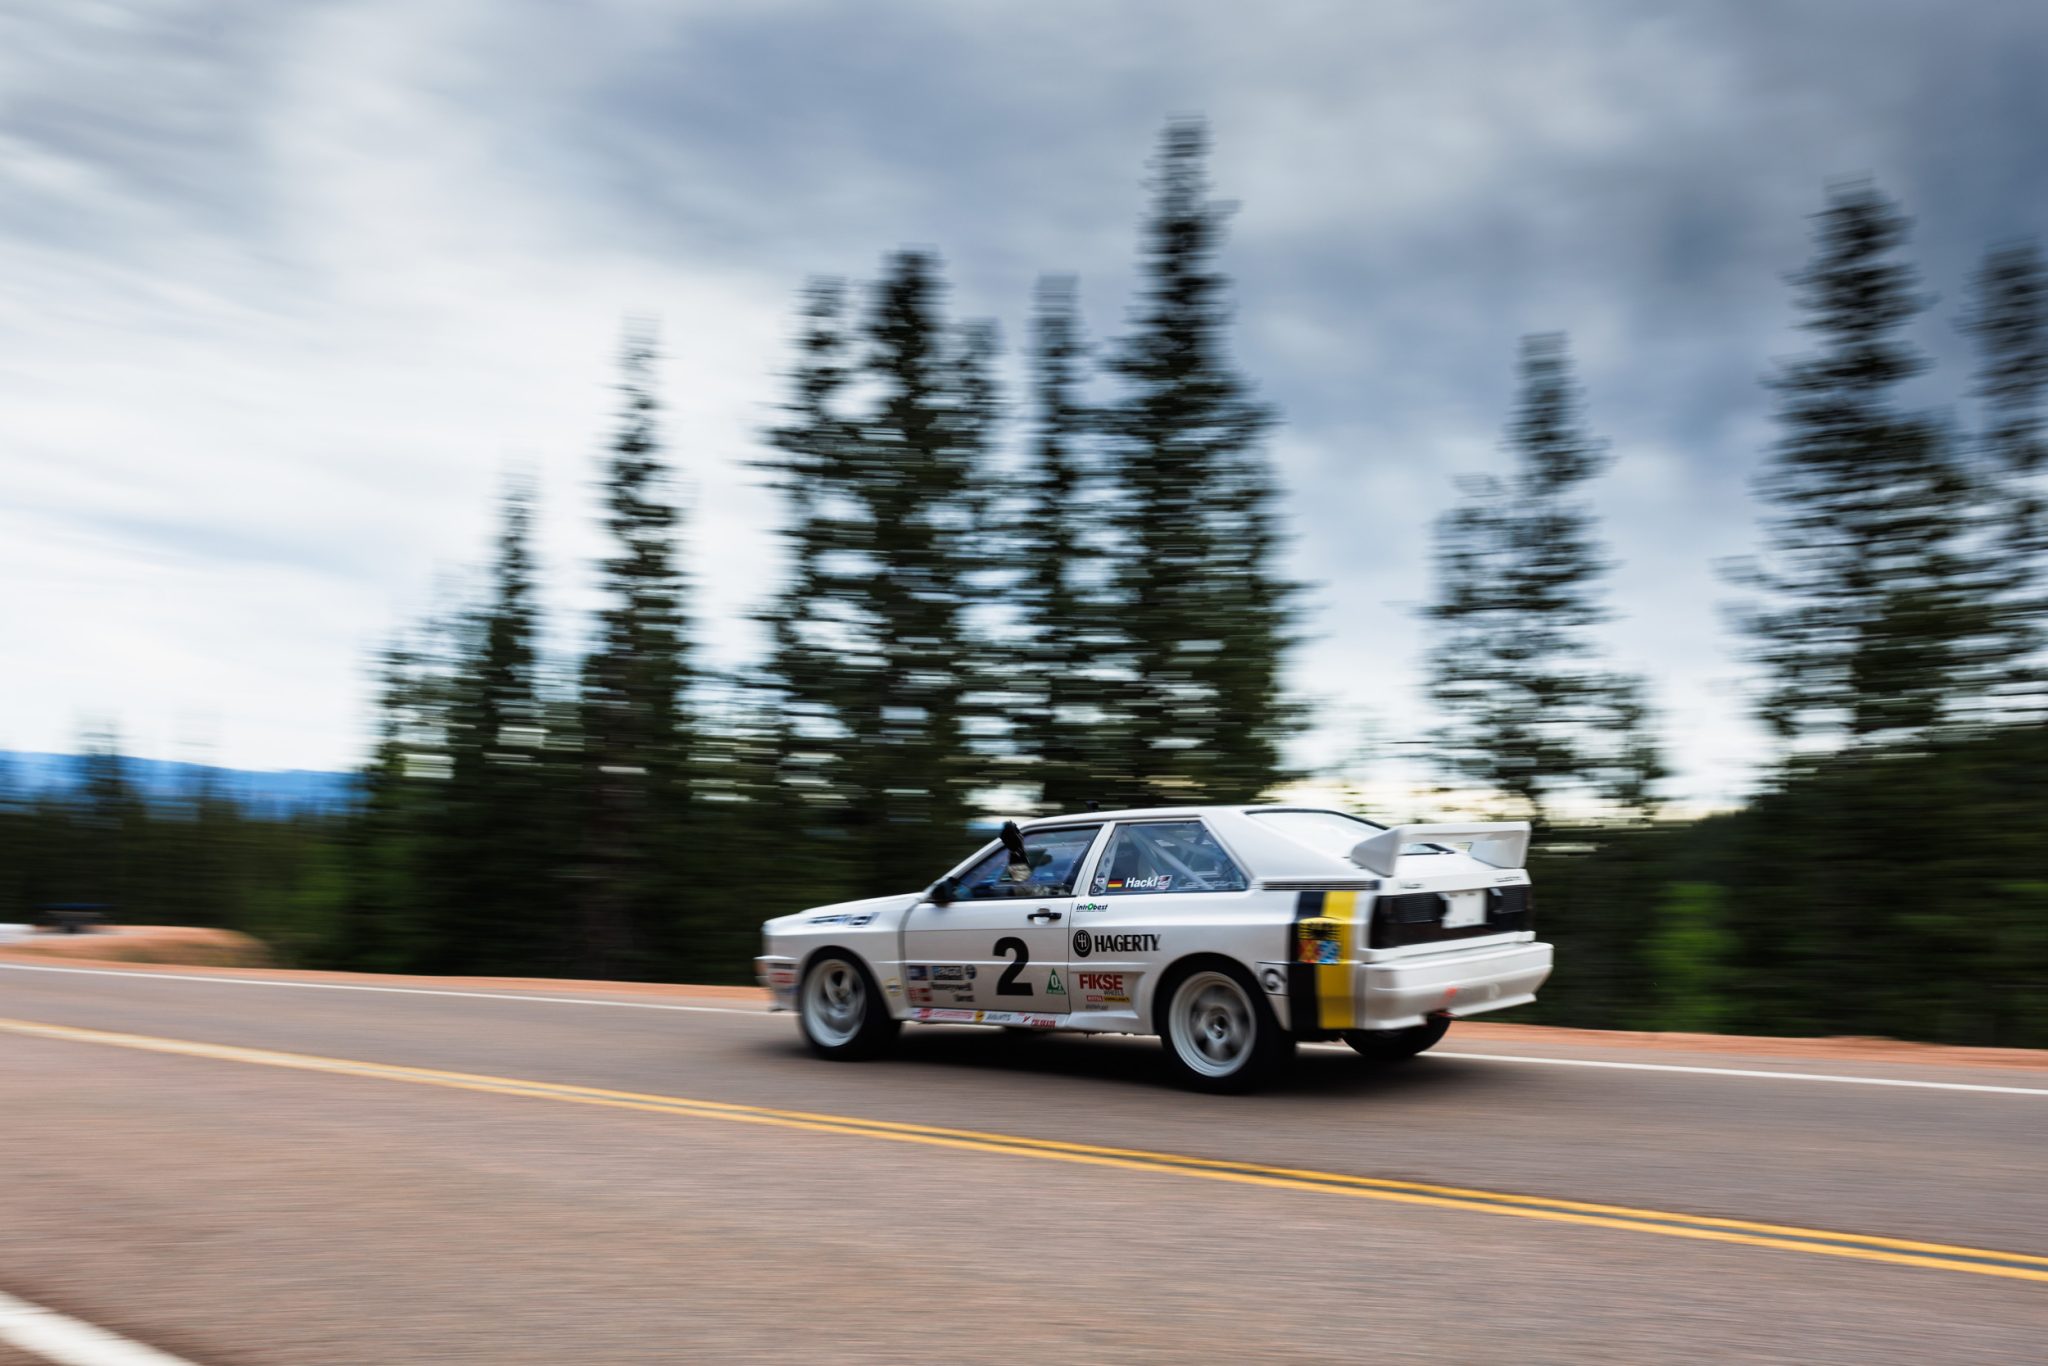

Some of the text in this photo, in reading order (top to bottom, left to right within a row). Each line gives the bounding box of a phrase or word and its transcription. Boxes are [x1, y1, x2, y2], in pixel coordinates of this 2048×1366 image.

[1125, 876, 1157, 889] Hackl
[1094, 934, 1161, 953] HAGERTY
[992, 936, 1034, 997] 2
[1079, 974, 1123, 991] FIKSE
